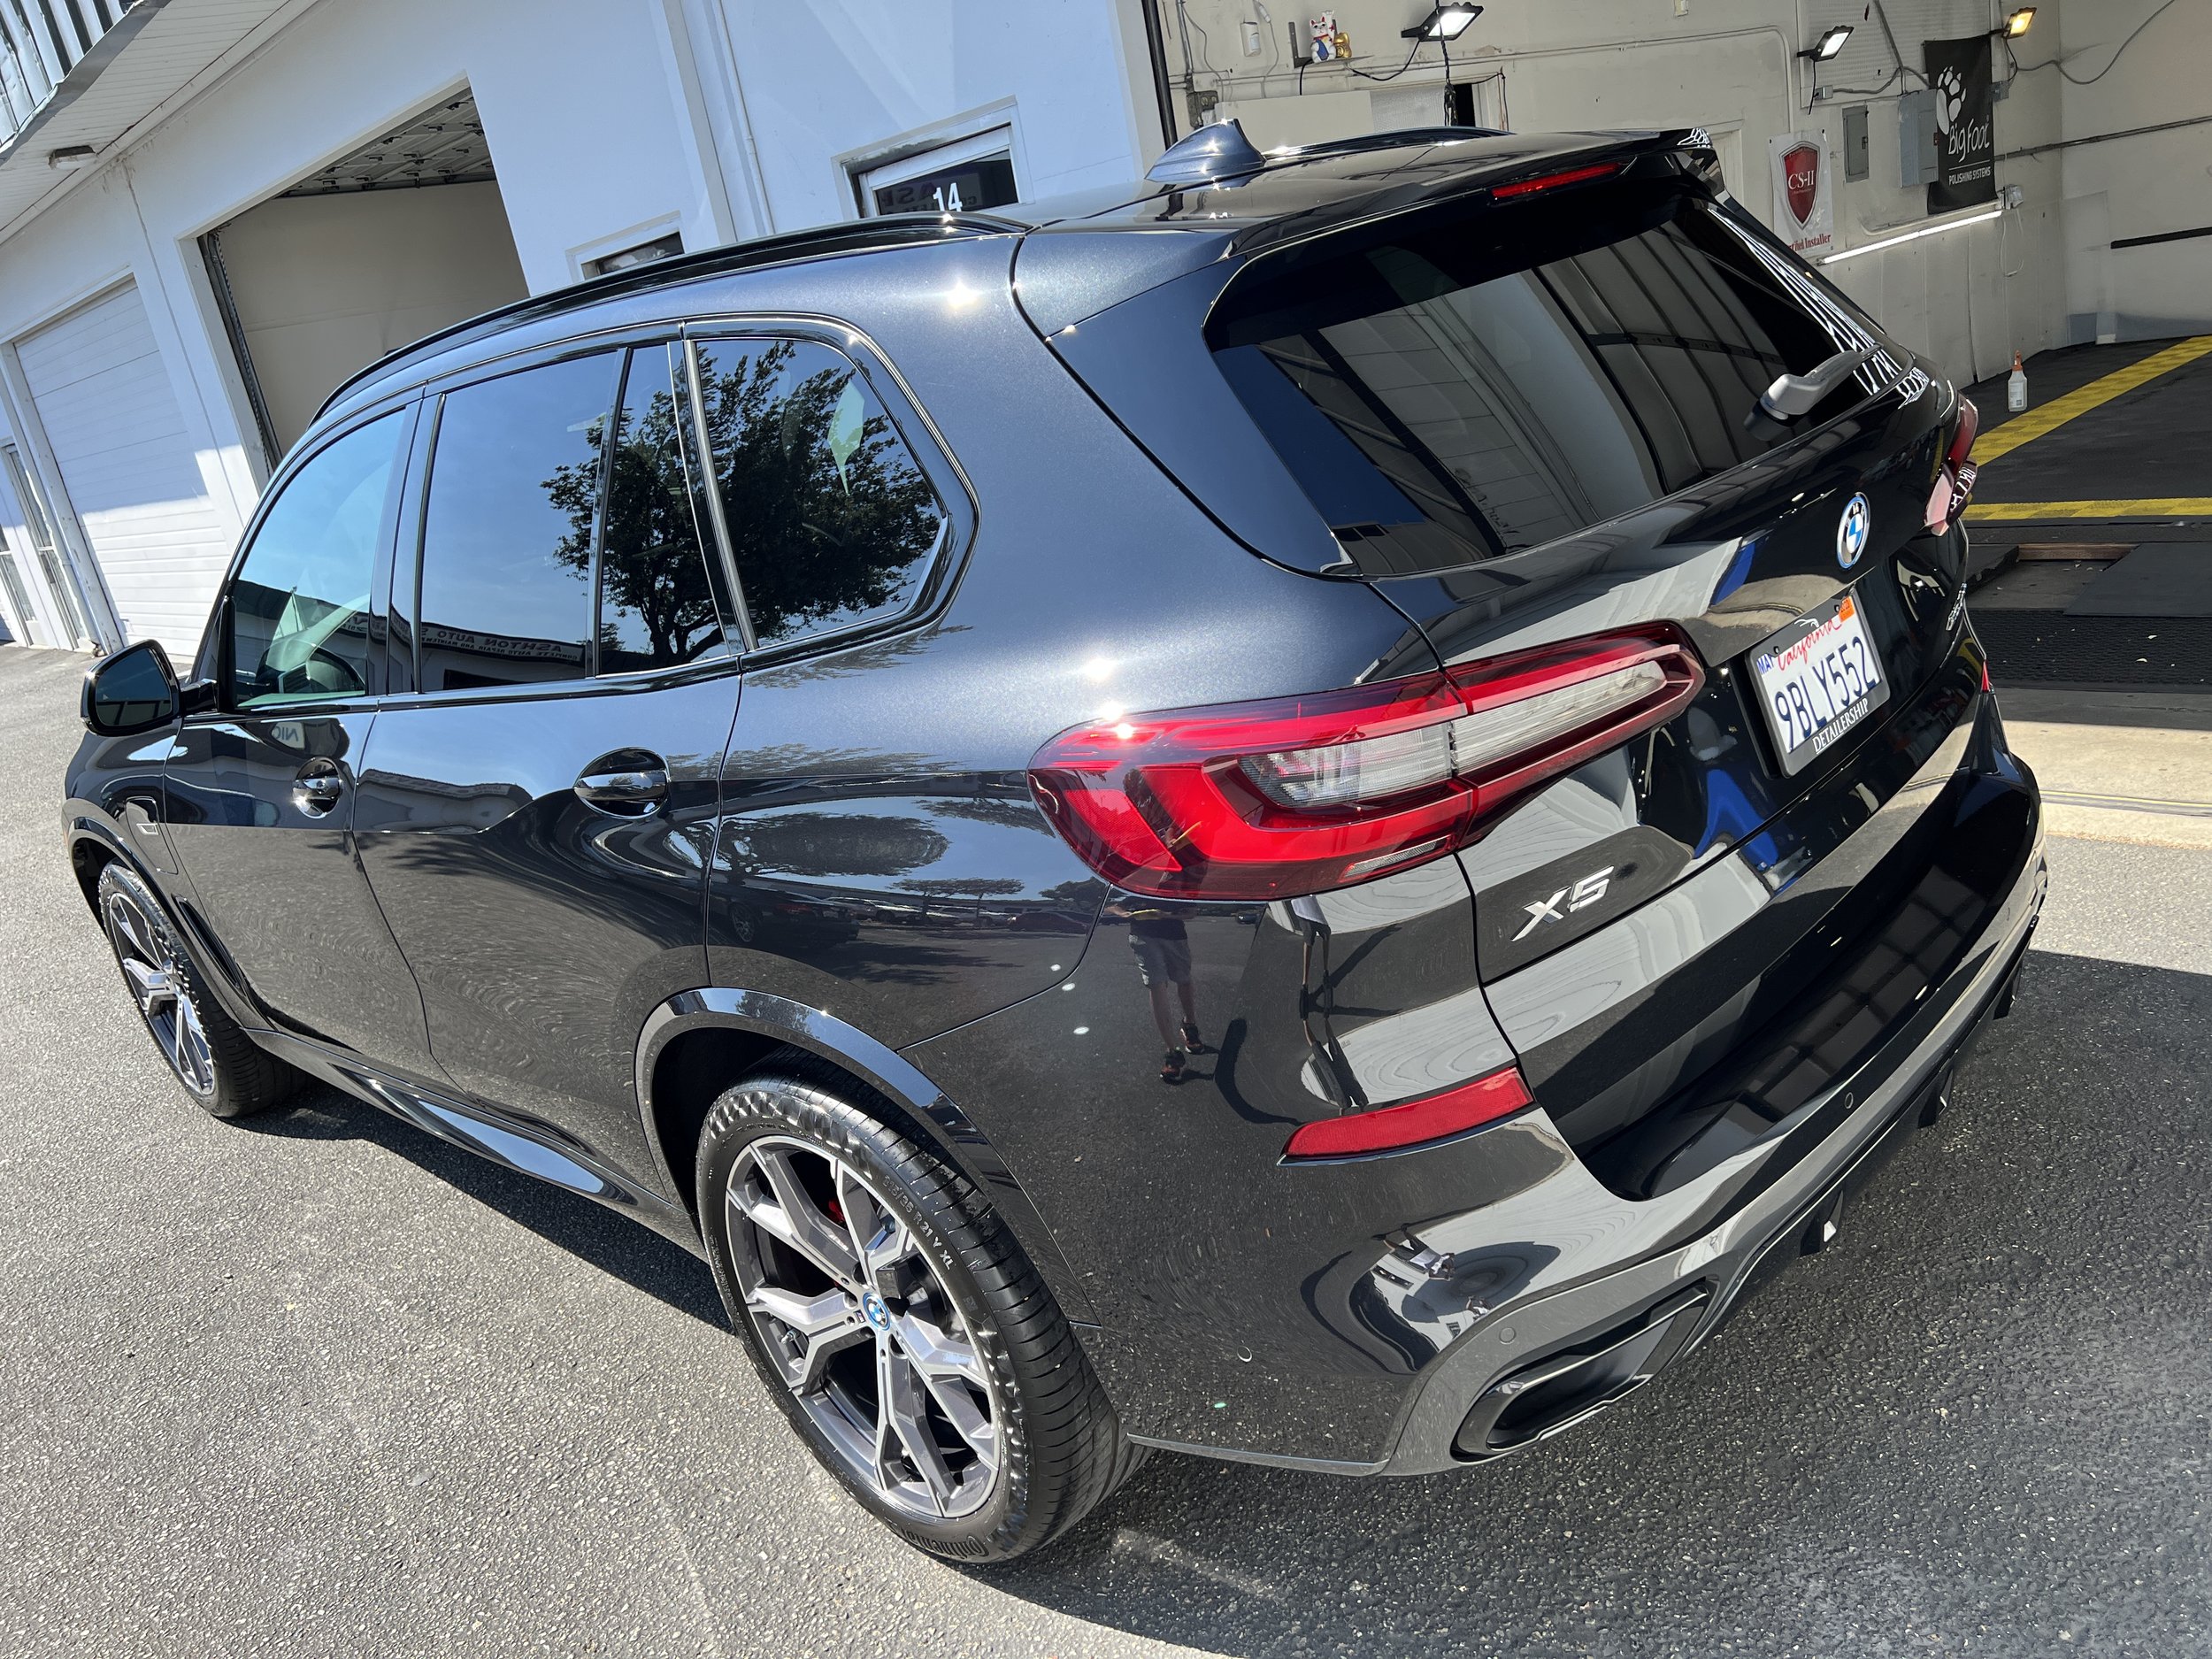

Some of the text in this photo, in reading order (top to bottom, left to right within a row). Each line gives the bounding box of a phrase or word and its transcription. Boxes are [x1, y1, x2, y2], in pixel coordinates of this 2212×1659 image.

[933, 182, 963, 212] 14
[1787, 170, 1815, 190] CS-II
[1948, 166, 1991, 186] POLISHING SYSTEMS
[1805, 233, 1832, 249] Installer
[1778, 618, 1842, 672] California
[1774, 635, 1877, 753] 9BLY552
[1812, 697, 1869, 753] DETAILERSHIP
[1509, 865, 1615, 942] X5
